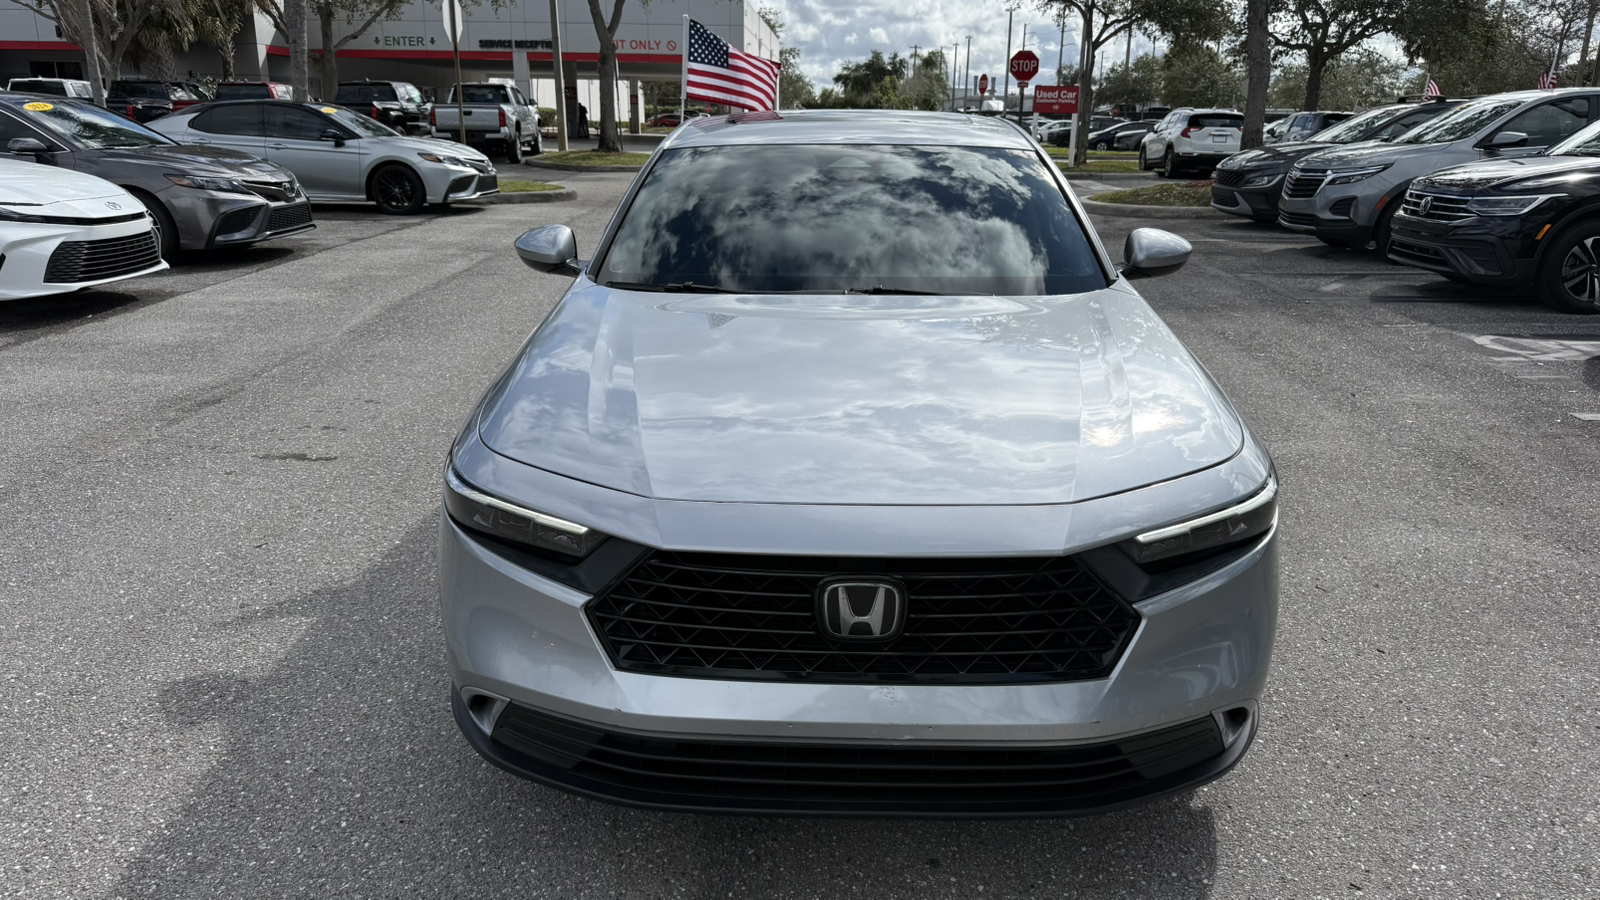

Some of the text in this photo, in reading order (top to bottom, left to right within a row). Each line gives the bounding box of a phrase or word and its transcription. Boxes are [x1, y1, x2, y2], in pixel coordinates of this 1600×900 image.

[384, 36, 425, 47] ENTER
[478, 39, 513, 49] SERVICE
[629, 39, 662, 50] ONLY
[1011, 60, 1038, 72] STOP
[1036, 90, 1077, 99] Used Car
